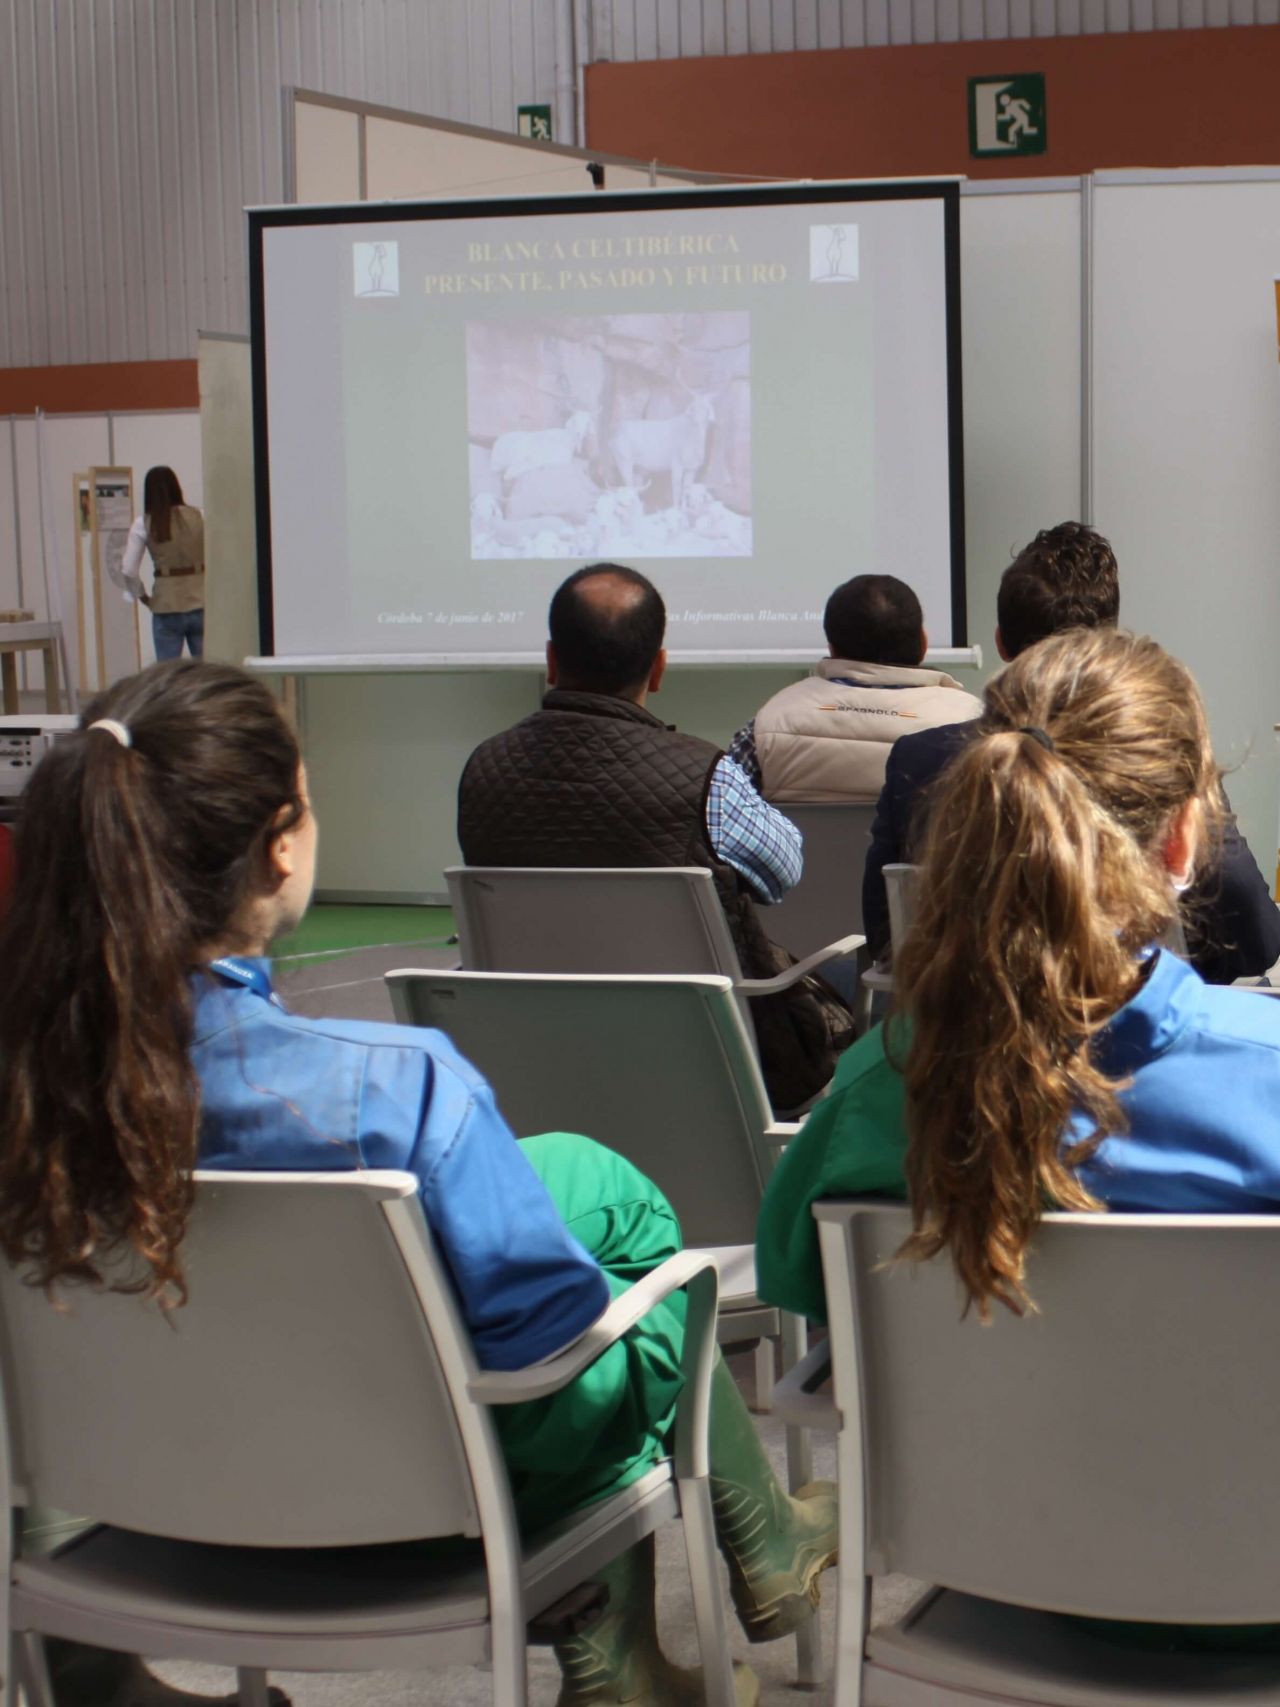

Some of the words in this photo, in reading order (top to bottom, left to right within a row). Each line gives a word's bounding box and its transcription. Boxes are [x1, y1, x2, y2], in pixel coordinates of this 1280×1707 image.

[466, 240, 566, 263] BLANCA
[558, 266, 657, 291] PASADO
[661, 266, 677, 287] Y
[685, 262, 790, 286] FUTURO
